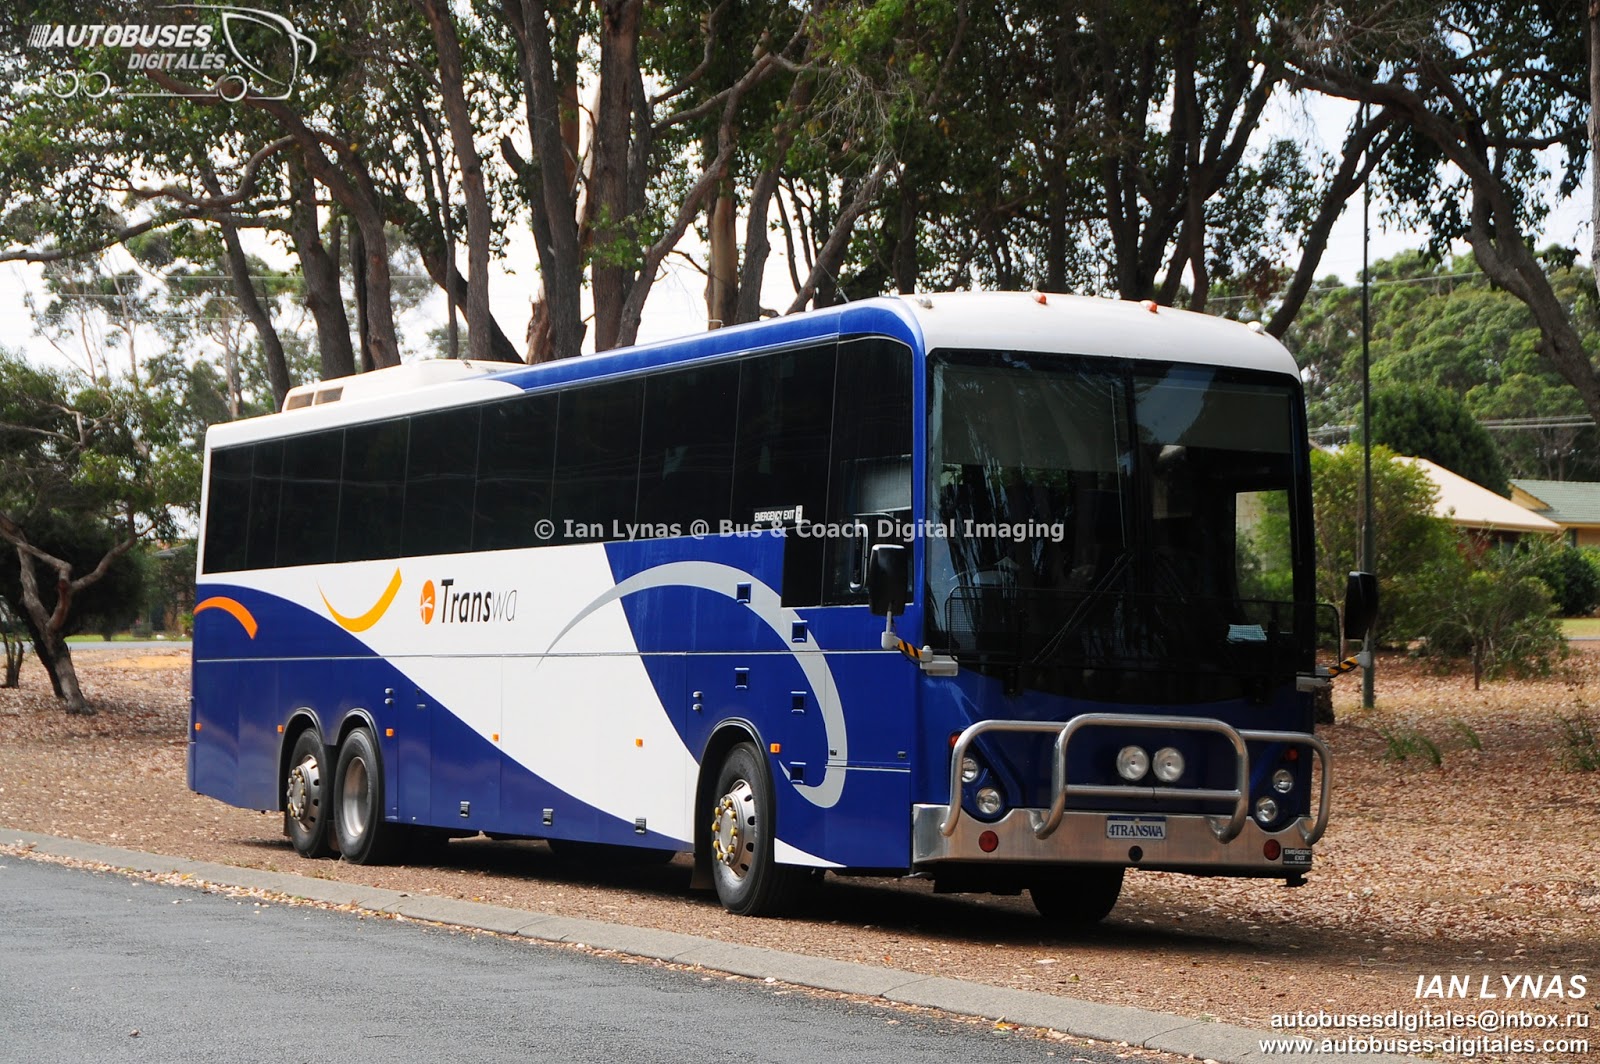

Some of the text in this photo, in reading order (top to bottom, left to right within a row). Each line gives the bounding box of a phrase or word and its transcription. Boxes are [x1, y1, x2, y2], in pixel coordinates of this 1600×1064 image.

[754, 511, 783, 522] EMERGENCY
[783, 509, 795, 520] EXIT
[441, 578, 517, 623] Transwa
[1109, 824, 1163, 837] 4TRANSWA
